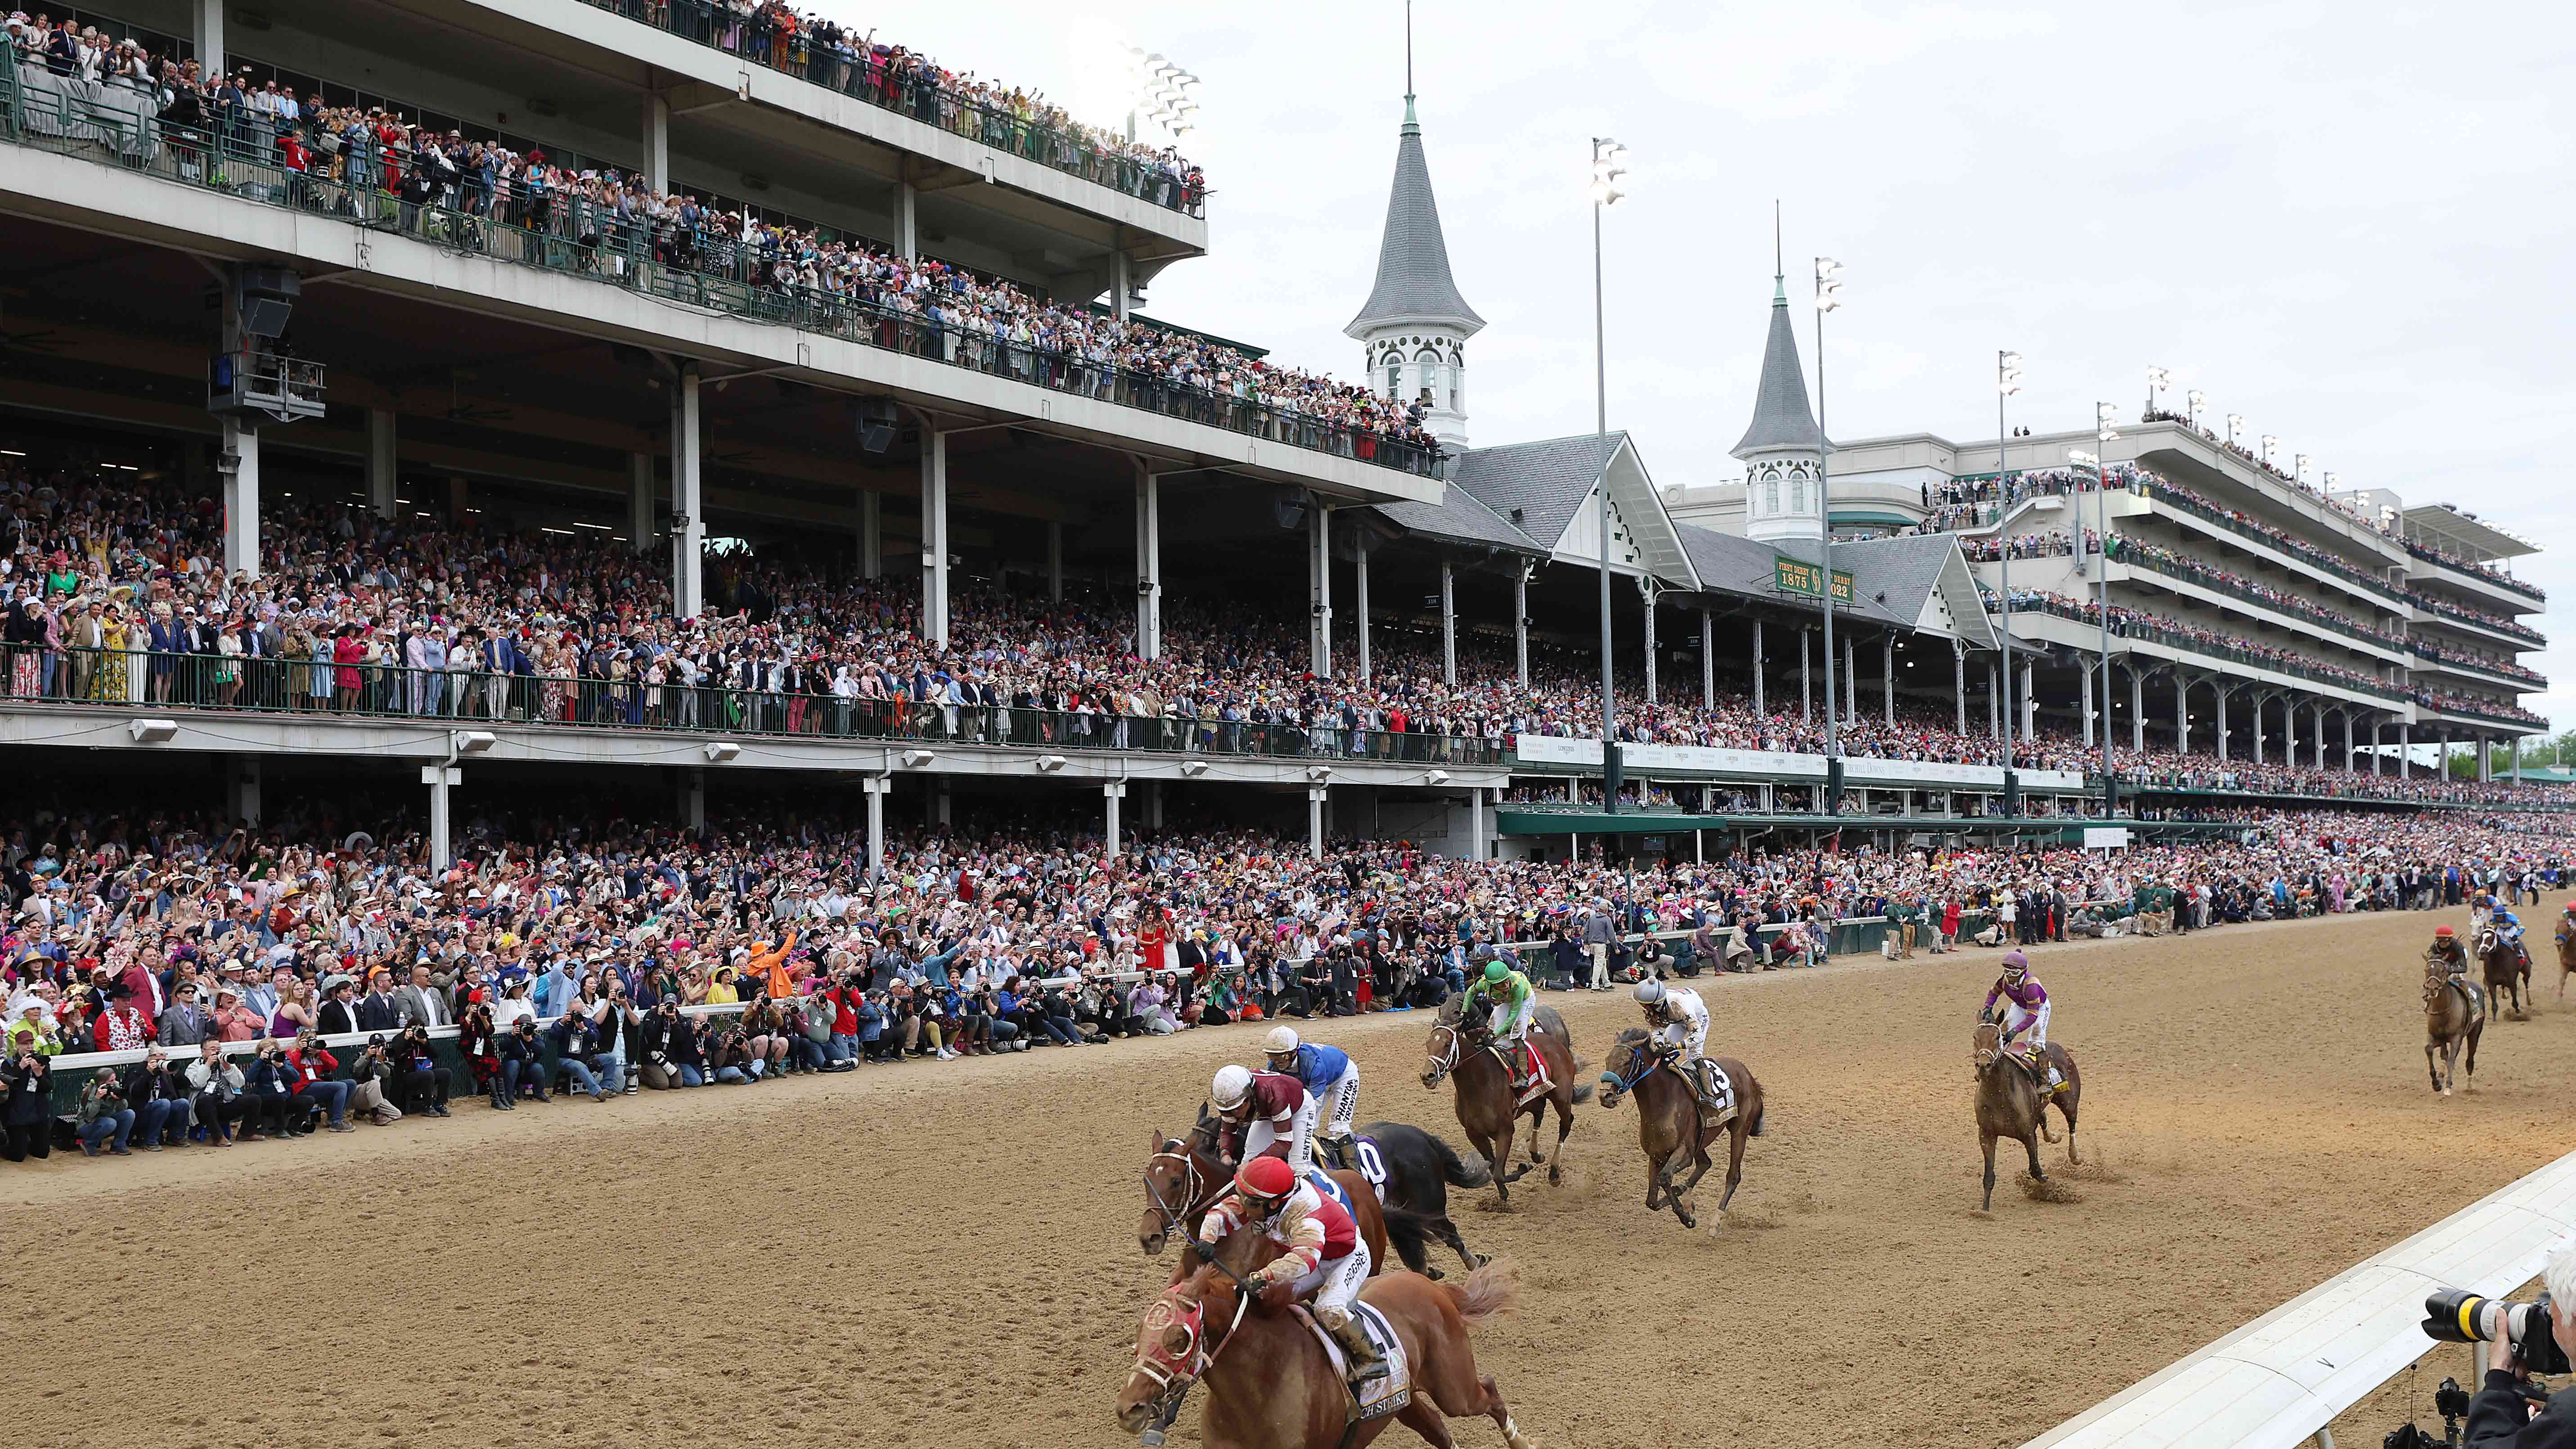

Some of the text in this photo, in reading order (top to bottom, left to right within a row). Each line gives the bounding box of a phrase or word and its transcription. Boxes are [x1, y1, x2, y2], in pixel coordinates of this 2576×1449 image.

[1779, 562, 1809, 576] FIRST DERBY
[1782, 572, 1807, 589] 1875
[1834, 575, 1851, 585] DERBY
[1830, 583, 1848, 598] 022
[1303, 1122, 1312, 1160] SENTIENT
[1357, 1142, 1386, 1184] 0
[1361, 1390, 1407, 1419] CH STRIKE
